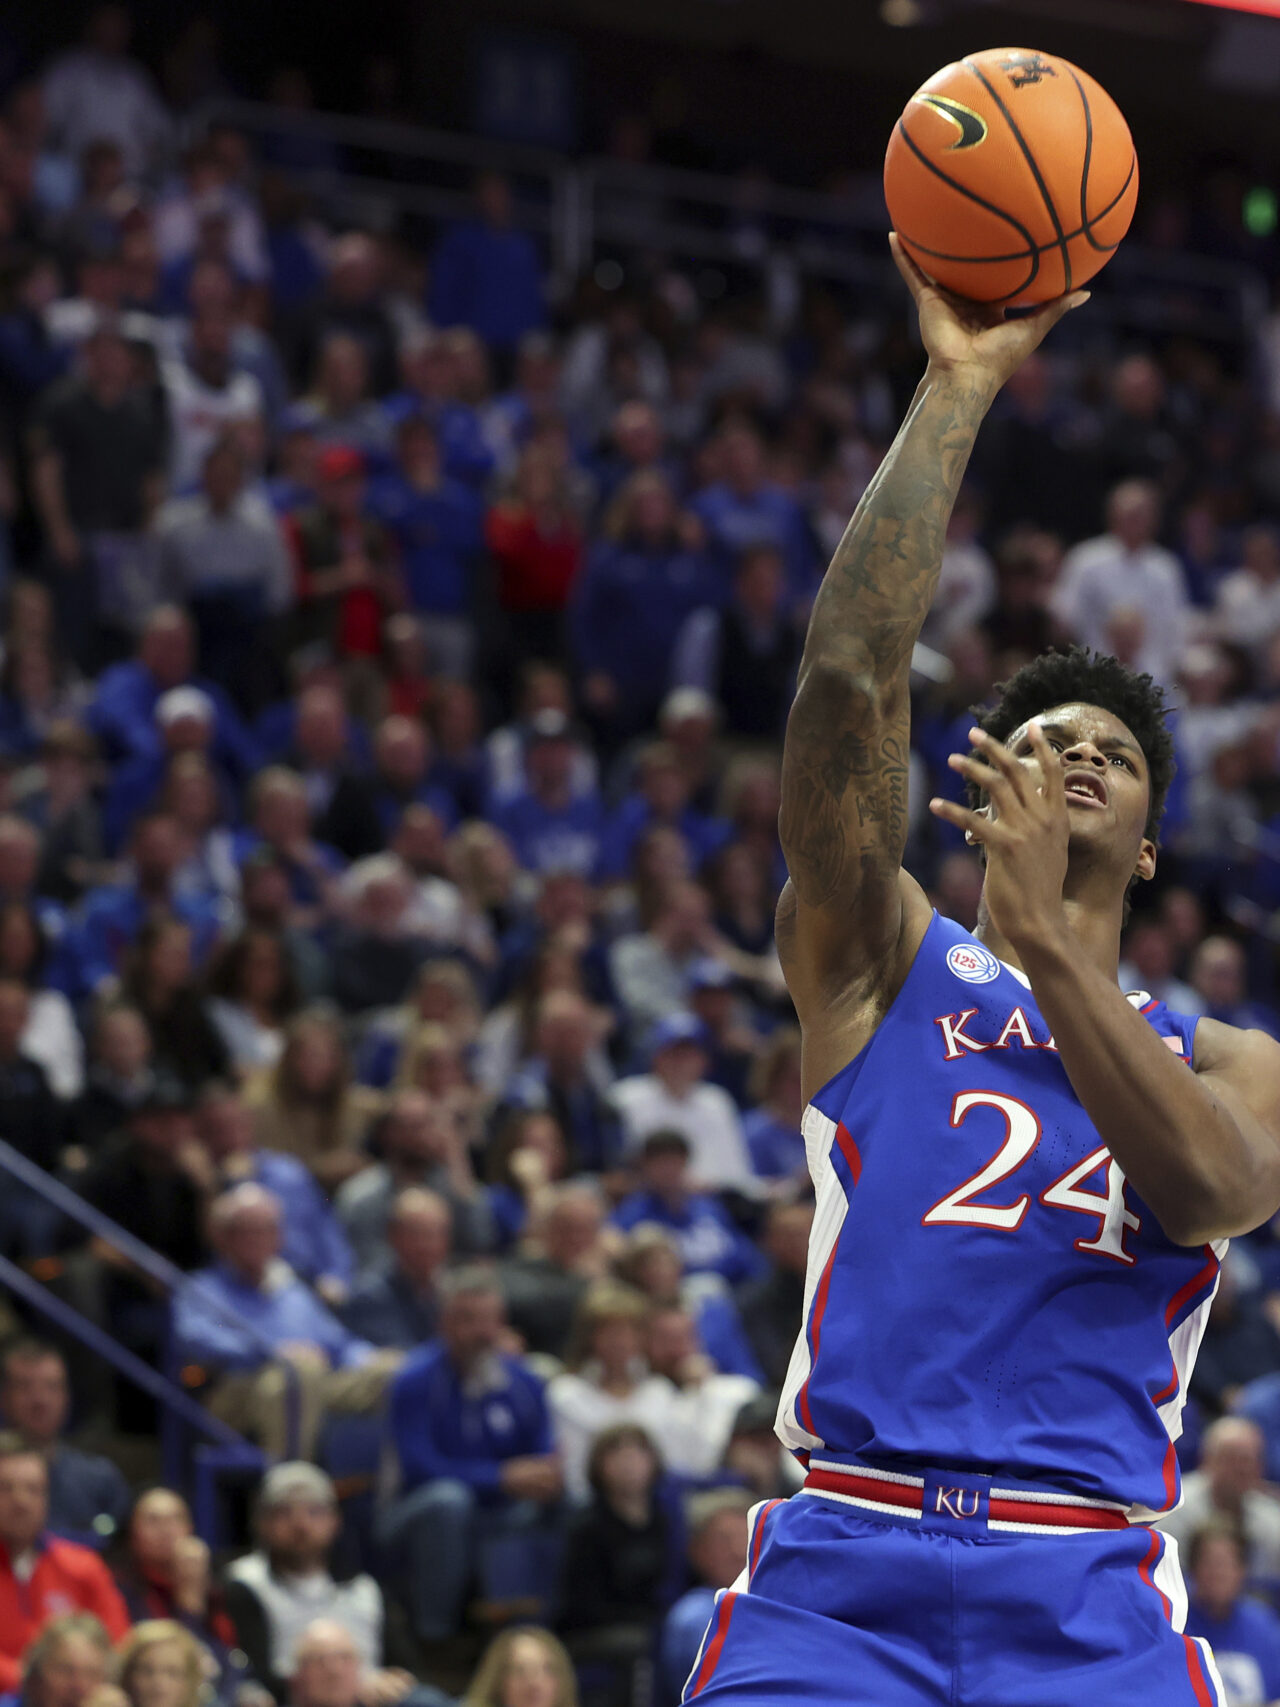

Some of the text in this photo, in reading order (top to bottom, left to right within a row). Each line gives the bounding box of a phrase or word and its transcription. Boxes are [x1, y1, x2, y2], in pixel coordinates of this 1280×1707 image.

[953, 952, 977, 970] 125
[934, 1006, 1060, 1061] KA
[921, 1089, 1142, 1266] 24
[934, 1485, 981, 1520] KU
